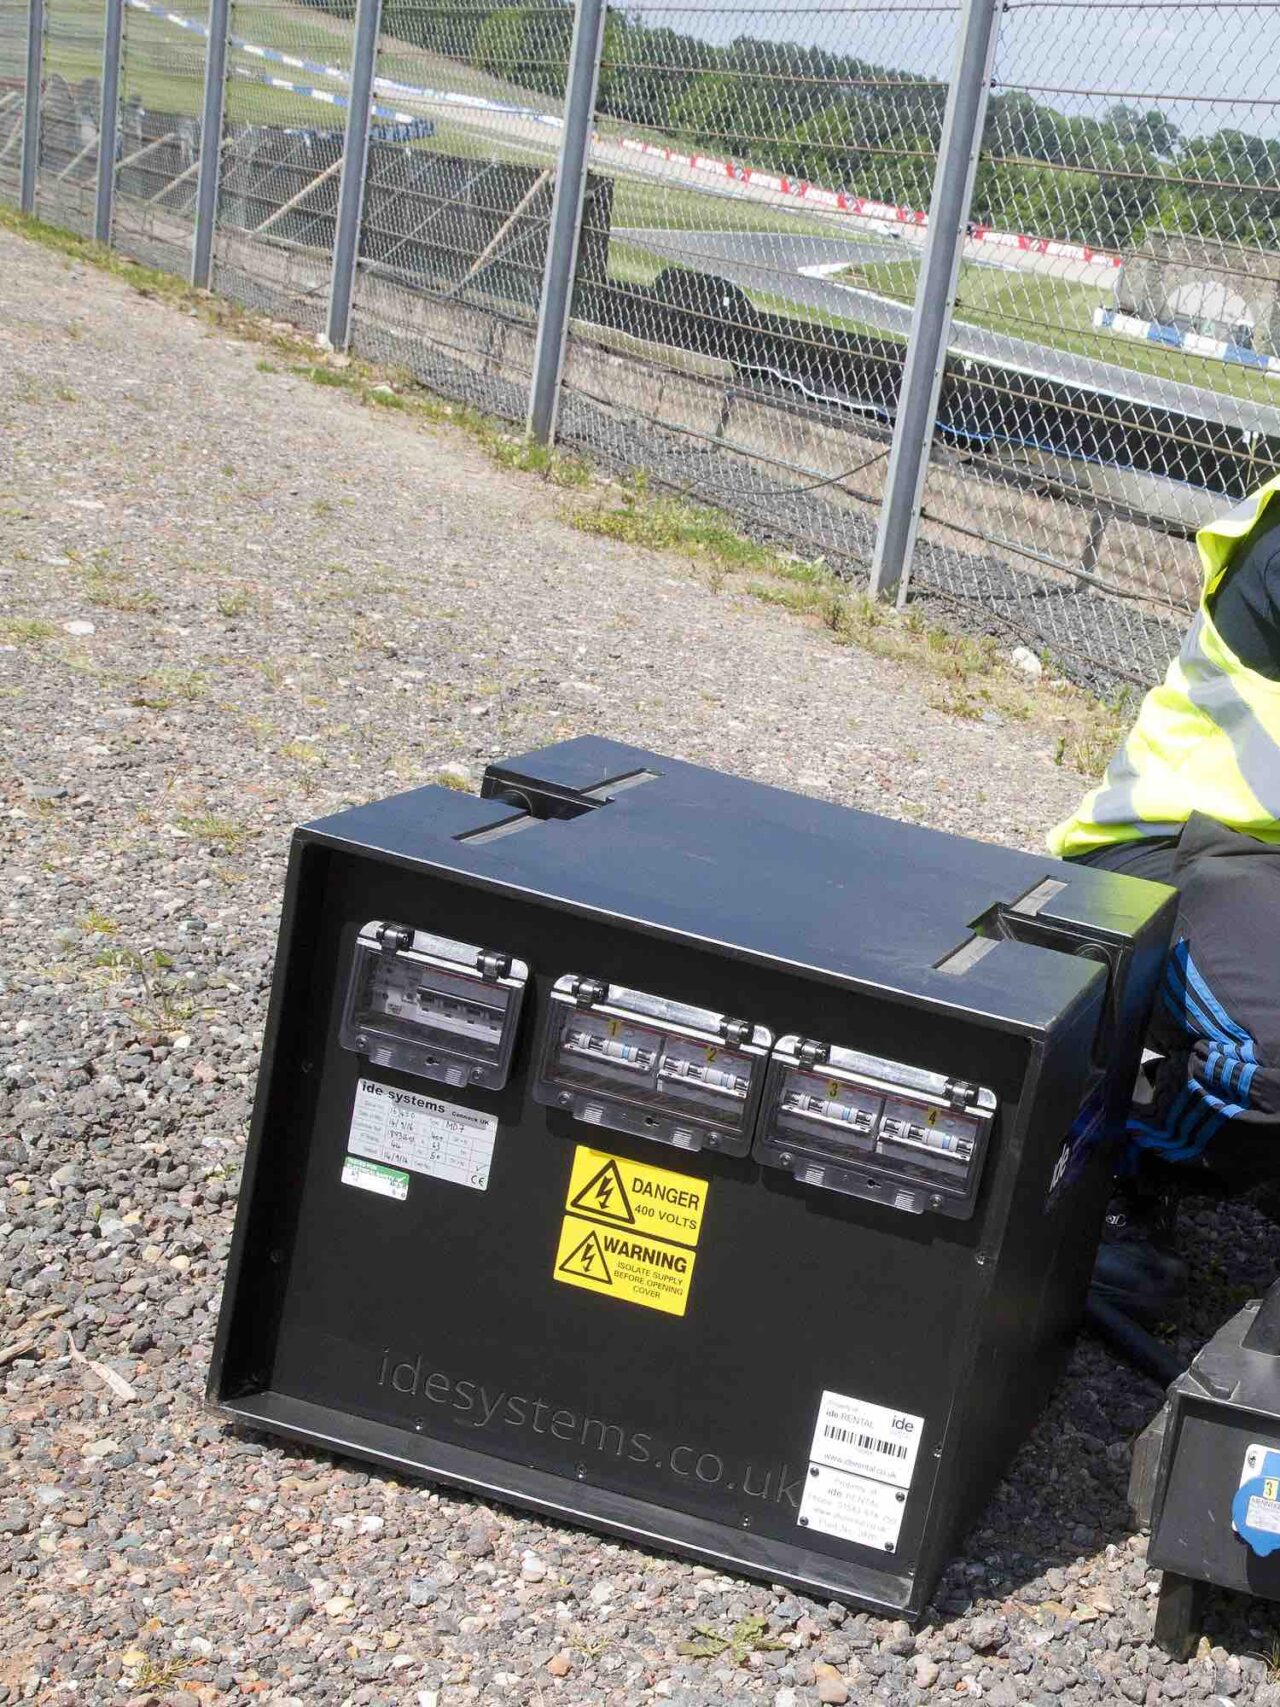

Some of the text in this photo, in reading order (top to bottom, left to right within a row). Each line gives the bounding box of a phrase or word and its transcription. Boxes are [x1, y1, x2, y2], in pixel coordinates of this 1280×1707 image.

[708, 1048, 717, 1062] 2
[362, 1081, 383, 1096] ide
[388, 1090, 446, 1114] systems
[829, 1082, 838, 1097] 3
[928, 1110, 937, 1125] 4
[631, 1177, 700, 1211] DANGER
[634, 1204, 698, 1231] 400 VOLTS
[603, 1235, 688, 1274] WARNING
[613, 1270, 684, 1296] BEFORE OPENING
[617, 1260, 684, 1287] ISOLATE SUPPLY
[632, 1285, 661, 1299] COVER
[376, 1345, 802, 1509] idesystems.co.uk
[891, 1414, 915, 1433] ide
[1264, 1480, 1274, 1496] 3
